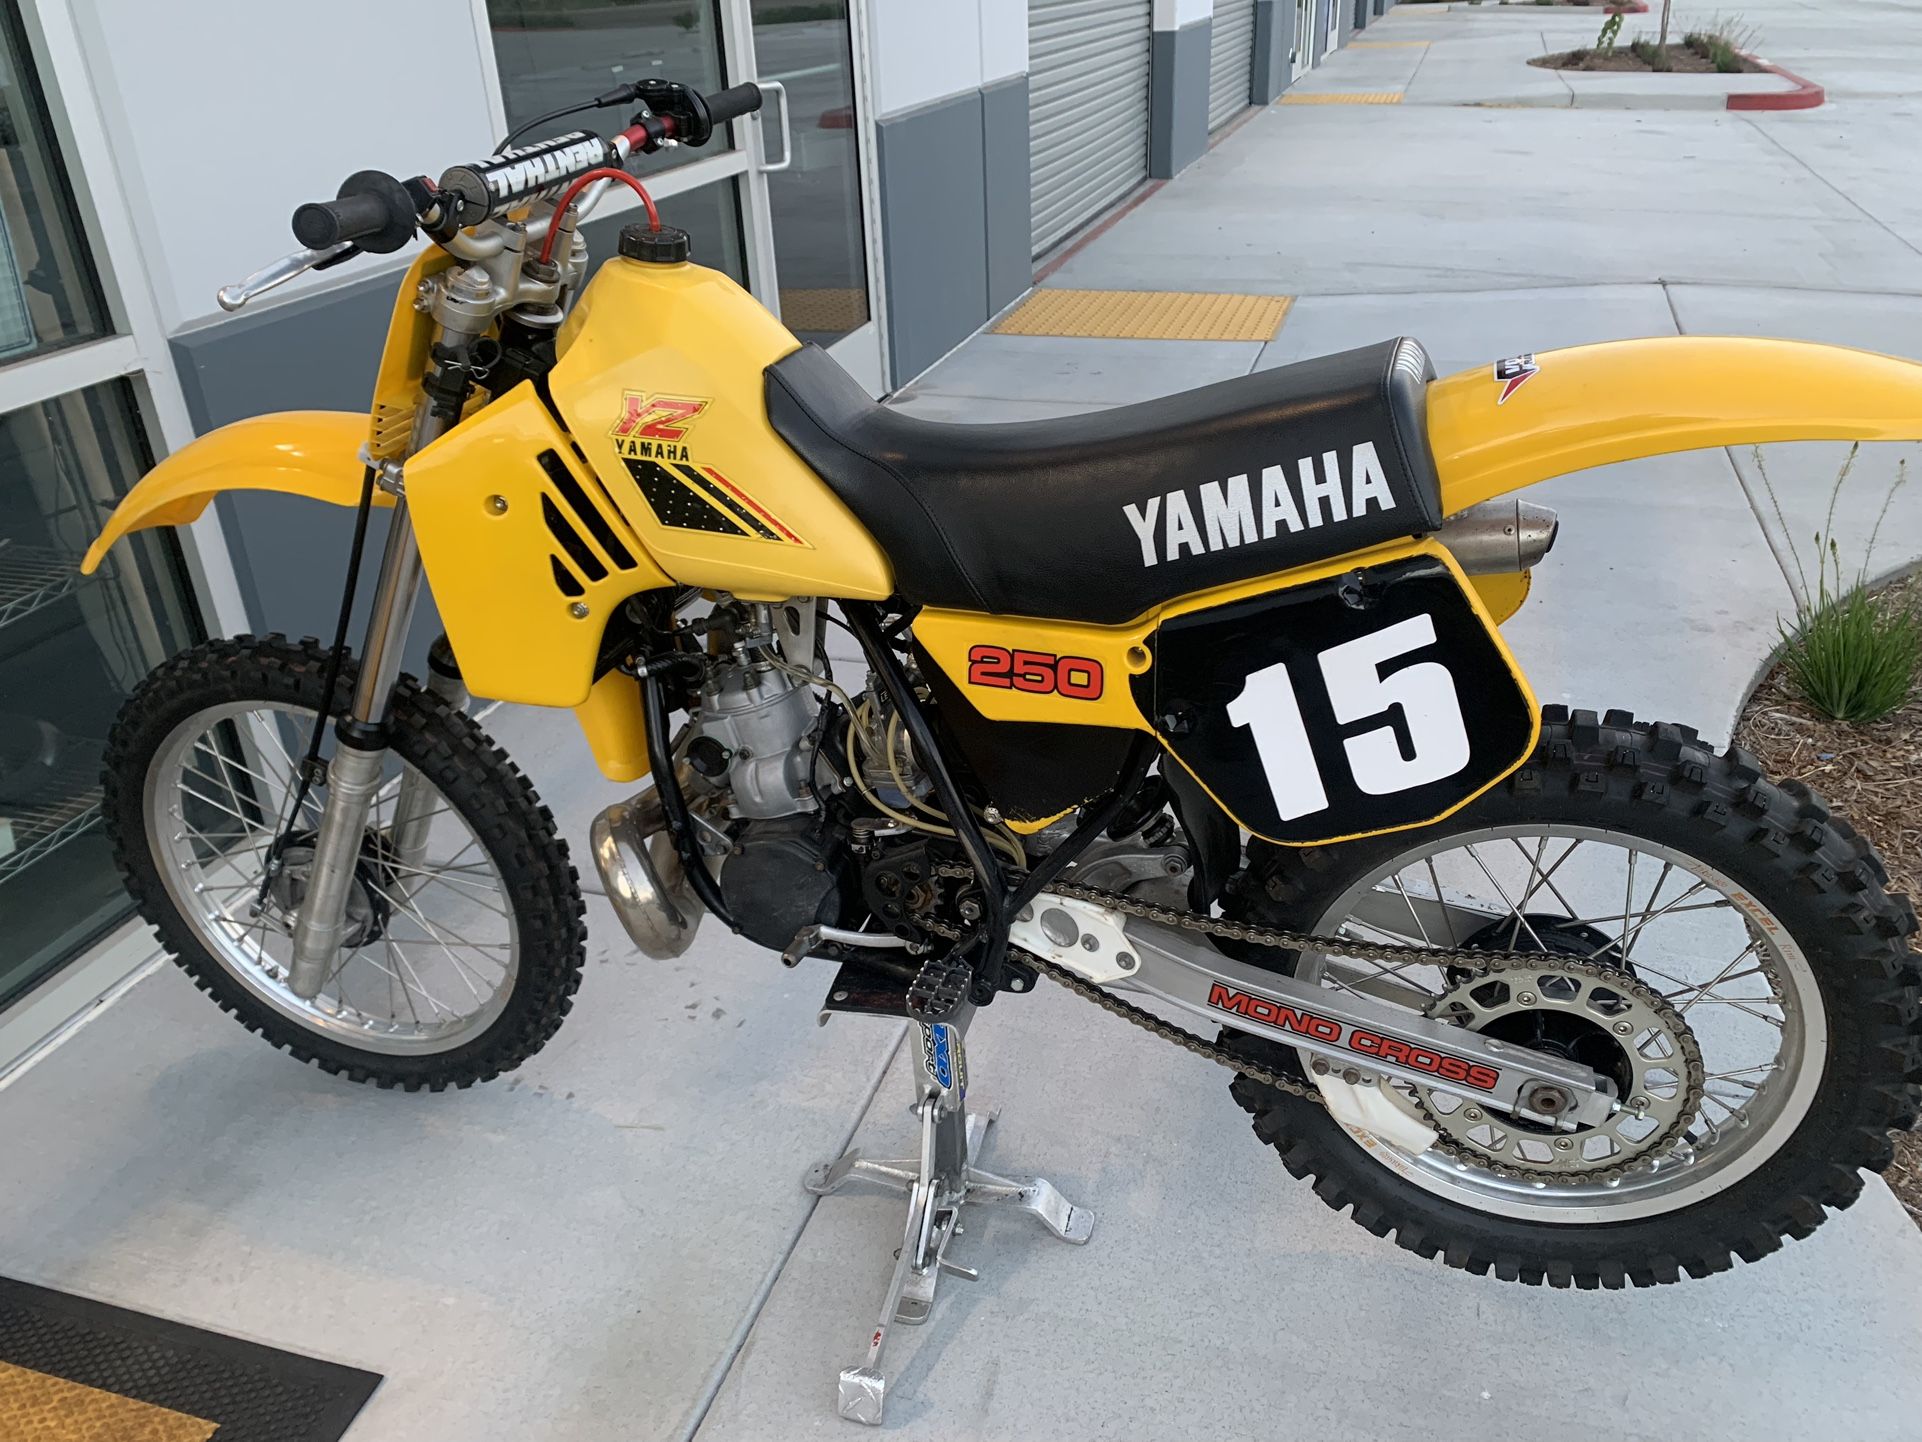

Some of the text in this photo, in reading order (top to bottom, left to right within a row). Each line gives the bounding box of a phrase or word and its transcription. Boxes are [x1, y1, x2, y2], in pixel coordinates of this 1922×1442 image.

[486, 137, 604, 199] RENTHAL
[612, 395, 708, 441] YZ
[615, 438, 690, 462] YAMAHA
[1122, 441, 1396, 567] YAMAHA
[968, 644, 1104, 701] 250
[1225, 613, 1470, 821] 15
[1730, 891, 1779, 936] EXCEL
[1208, 983, 1500, 1089] MONO CROSS
